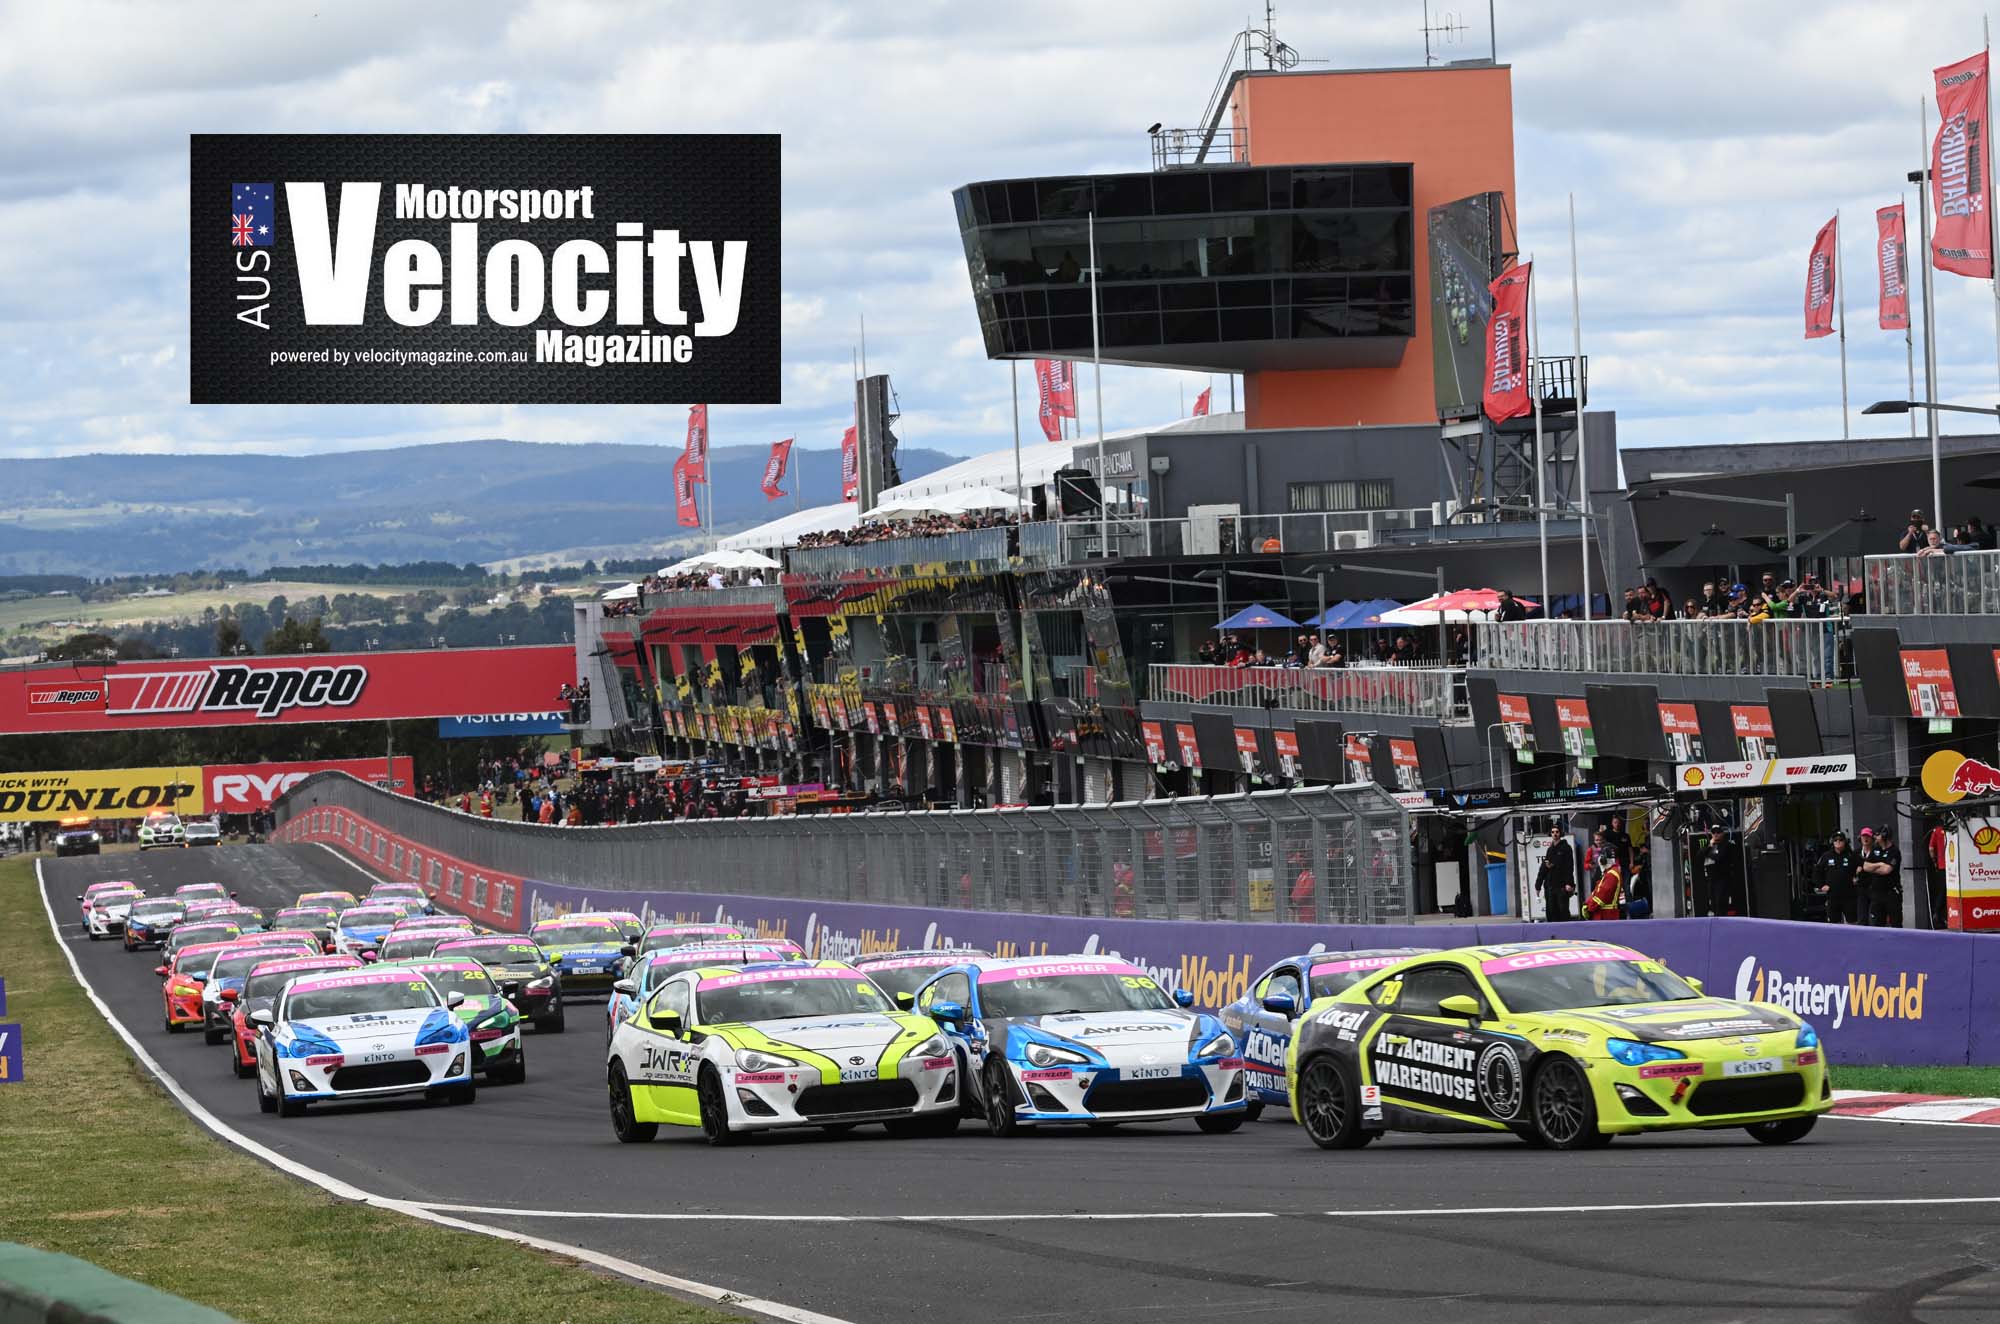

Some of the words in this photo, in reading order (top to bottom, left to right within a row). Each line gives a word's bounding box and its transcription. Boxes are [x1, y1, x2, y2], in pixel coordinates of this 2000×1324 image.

[56, 690, 99, 704] Repco
[201, 664, 368, 718] Repco
[1711, 771, 1750, 781] V-Power
[1810, 763, 1848, 776] Repco
[31, 777, 69, 788] WITH
[0, 784, 196, 813] DUNLOP
[1258, 842, 1273, 857] 19
[397, 932, 466, 941] STEWART
[232, 947, 297, 959] LOGAN
[508, 944, 539, 954] 333
[1508, 949, 1626, 968] CASHA
[259, 959, 356, 975] STINSON
[1016, 963, 1109, 977] BURCHER
[315, 974, 399, 989] TOMSETT
[463, 970, 486, 980] 25
[718, 968, 841, 986] WESTBURY
[408, 981, 427, 991] 27
[1119, 976, 1157, 990] 36
[1376, 980, 1404, 1005] 79
[325, 1017, 418, 1033] Baseline
[1316, 1007, 1370, 1031] Local
[1083, 1024, 1173, 1036] AWCON
[639, 1047, 682, 1072] JWR
[1374, 1059, 1477, 1102] WAREHOUSE
